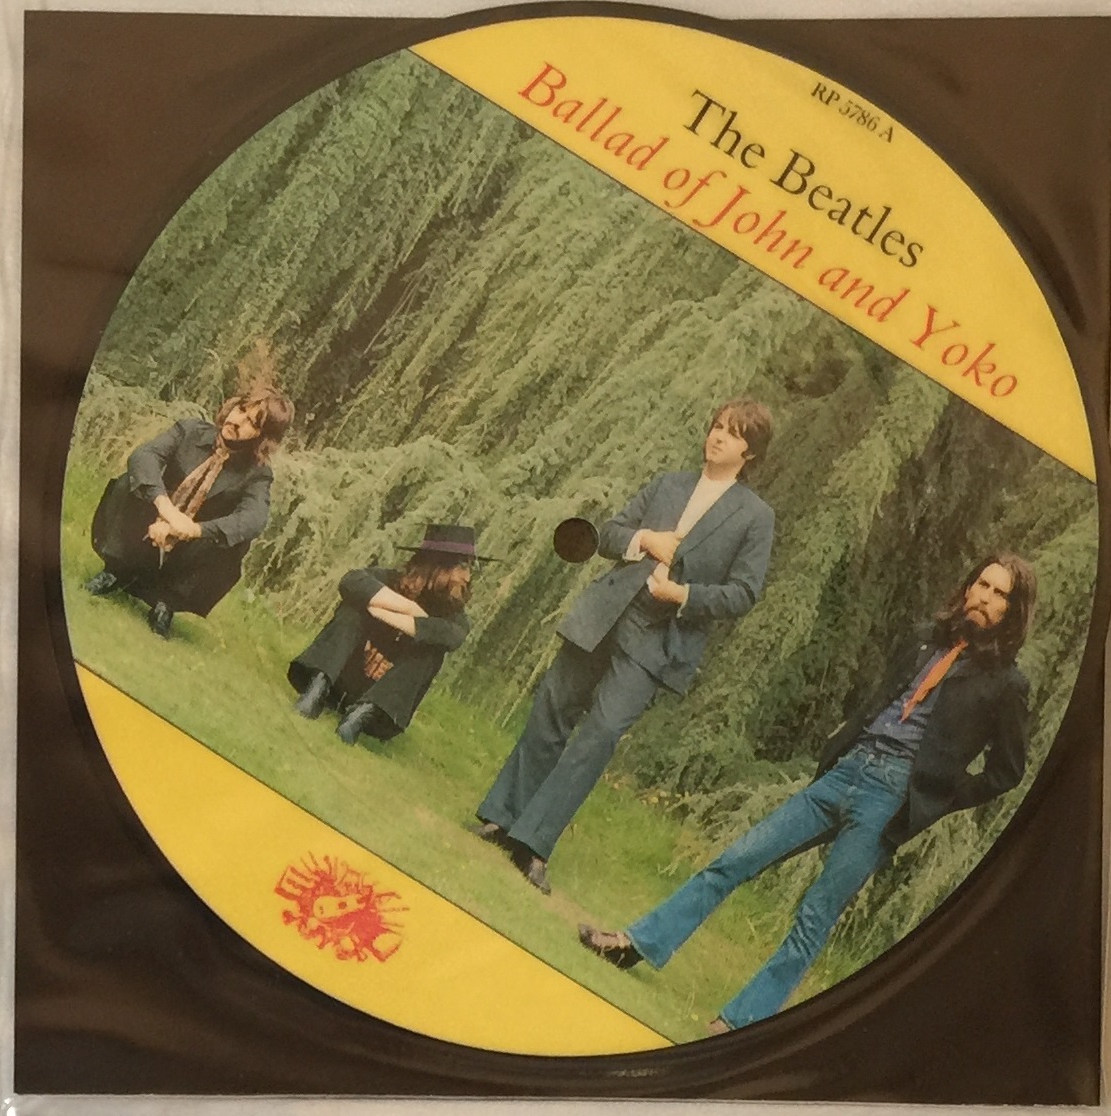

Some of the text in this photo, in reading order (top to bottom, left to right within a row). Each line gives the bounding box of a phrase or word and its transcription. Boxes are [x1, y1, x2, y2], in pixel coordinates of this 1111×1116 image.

[683, 89, 924, 268] The Beatles
[810, 82, 893, 143] RP 5786 A
[517, 62, 1019, 399] Ballad of John and Yoko
